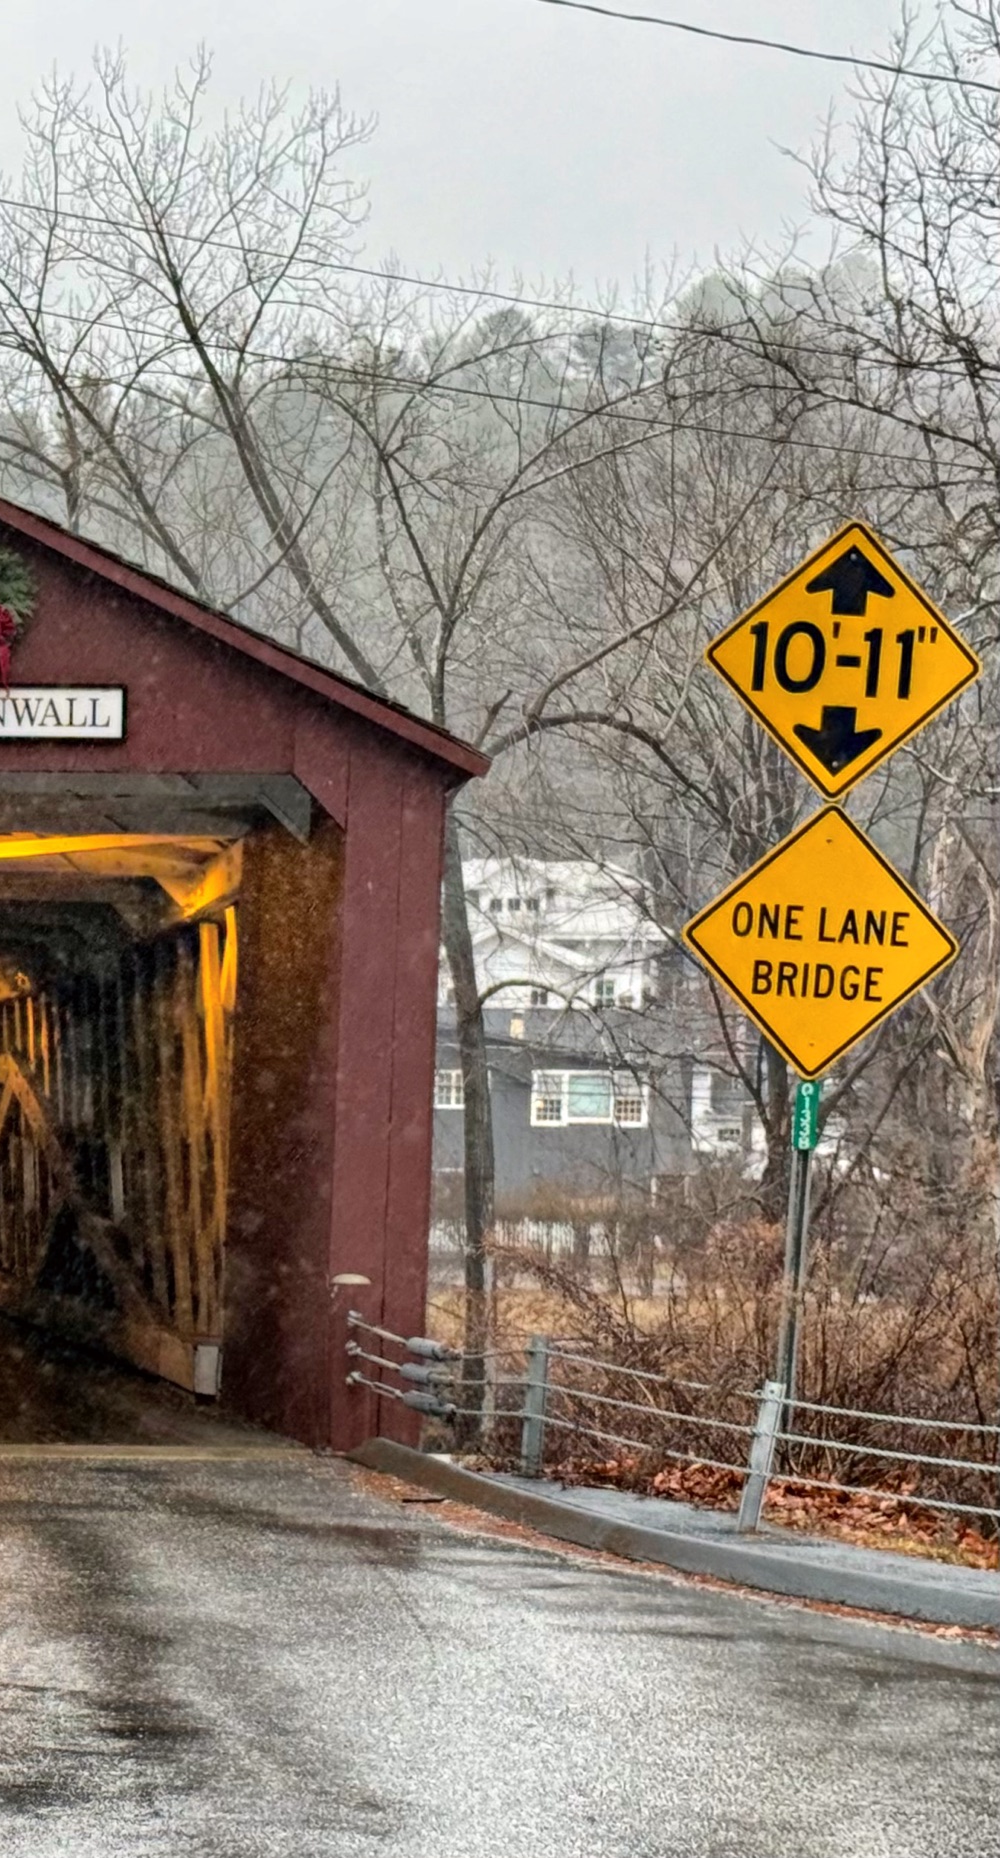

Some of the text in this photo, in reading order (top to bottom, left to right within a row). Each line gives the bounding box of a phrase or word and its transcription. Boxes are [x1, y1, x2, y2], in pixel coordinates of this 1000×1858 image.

[732, 901, 911, 948] ONE LANE
[751, 959, 884, 1003] BRIDGE
